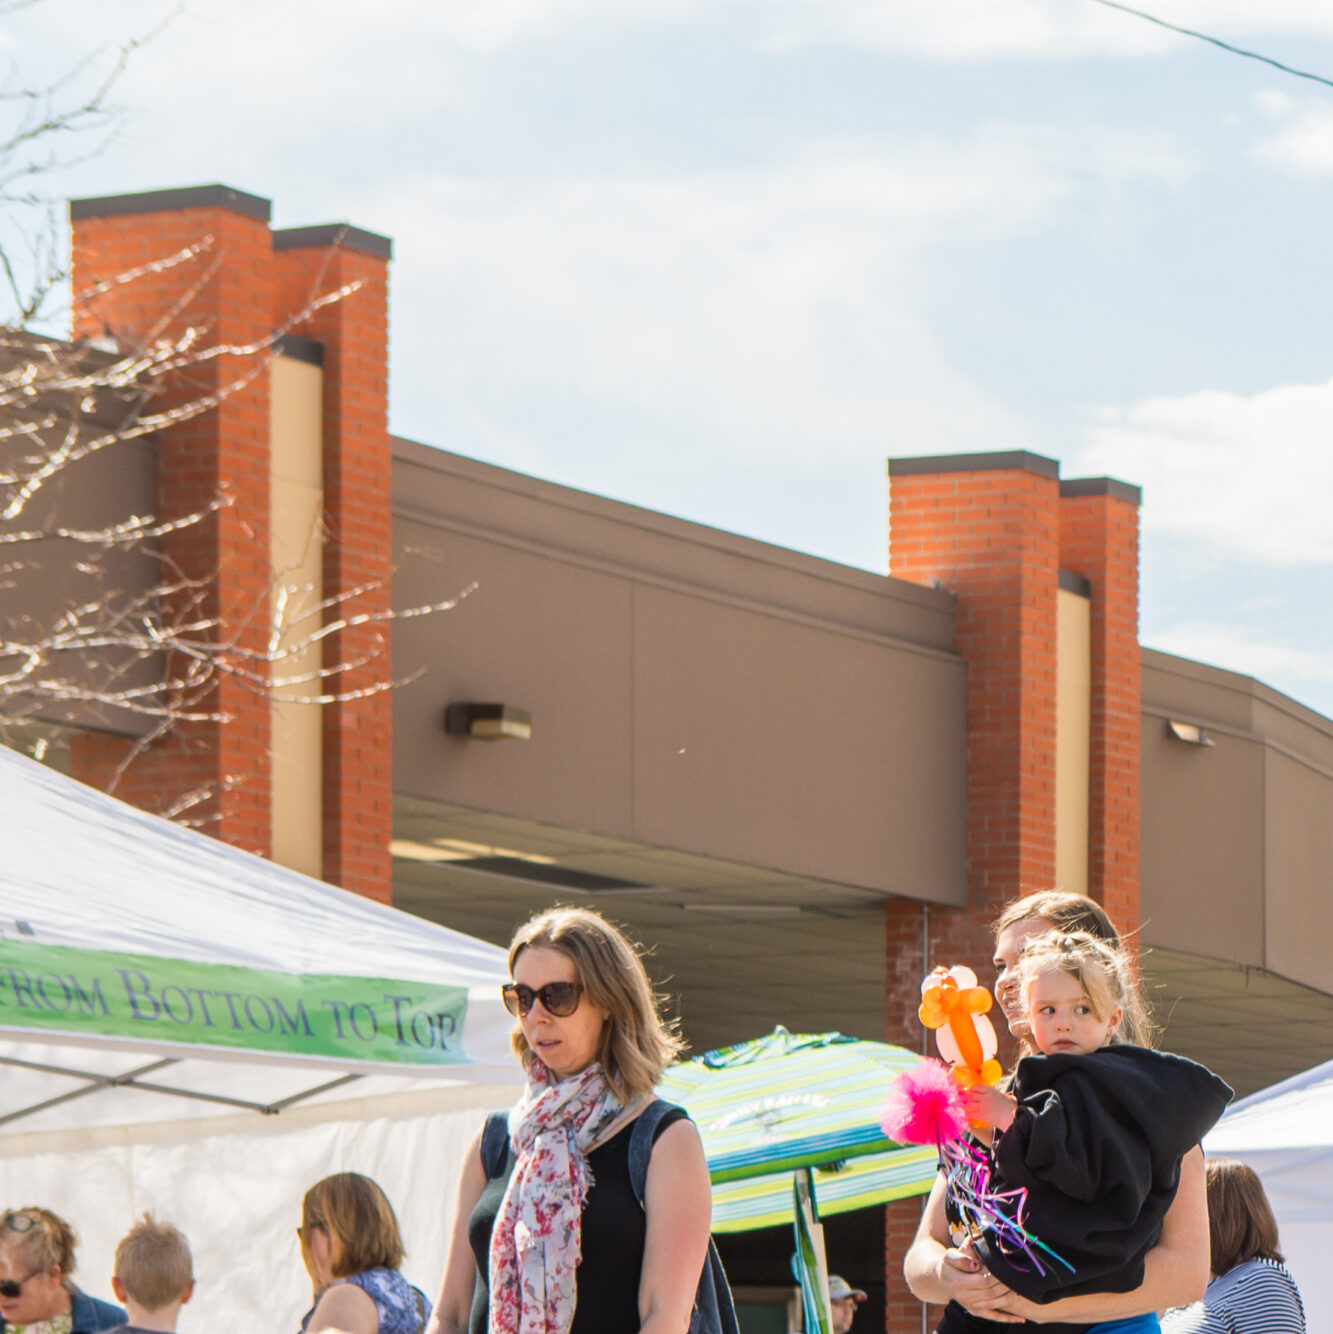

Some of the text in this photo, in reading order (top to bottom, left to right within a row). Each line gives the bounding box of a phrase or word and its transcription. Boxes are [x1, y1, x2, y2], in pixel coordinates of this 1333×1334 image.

[0, 966, 113, 1017] ROM
[115, 967, 315, 1038] BOTTOM
[383, 994, 457, 1052] TOP
